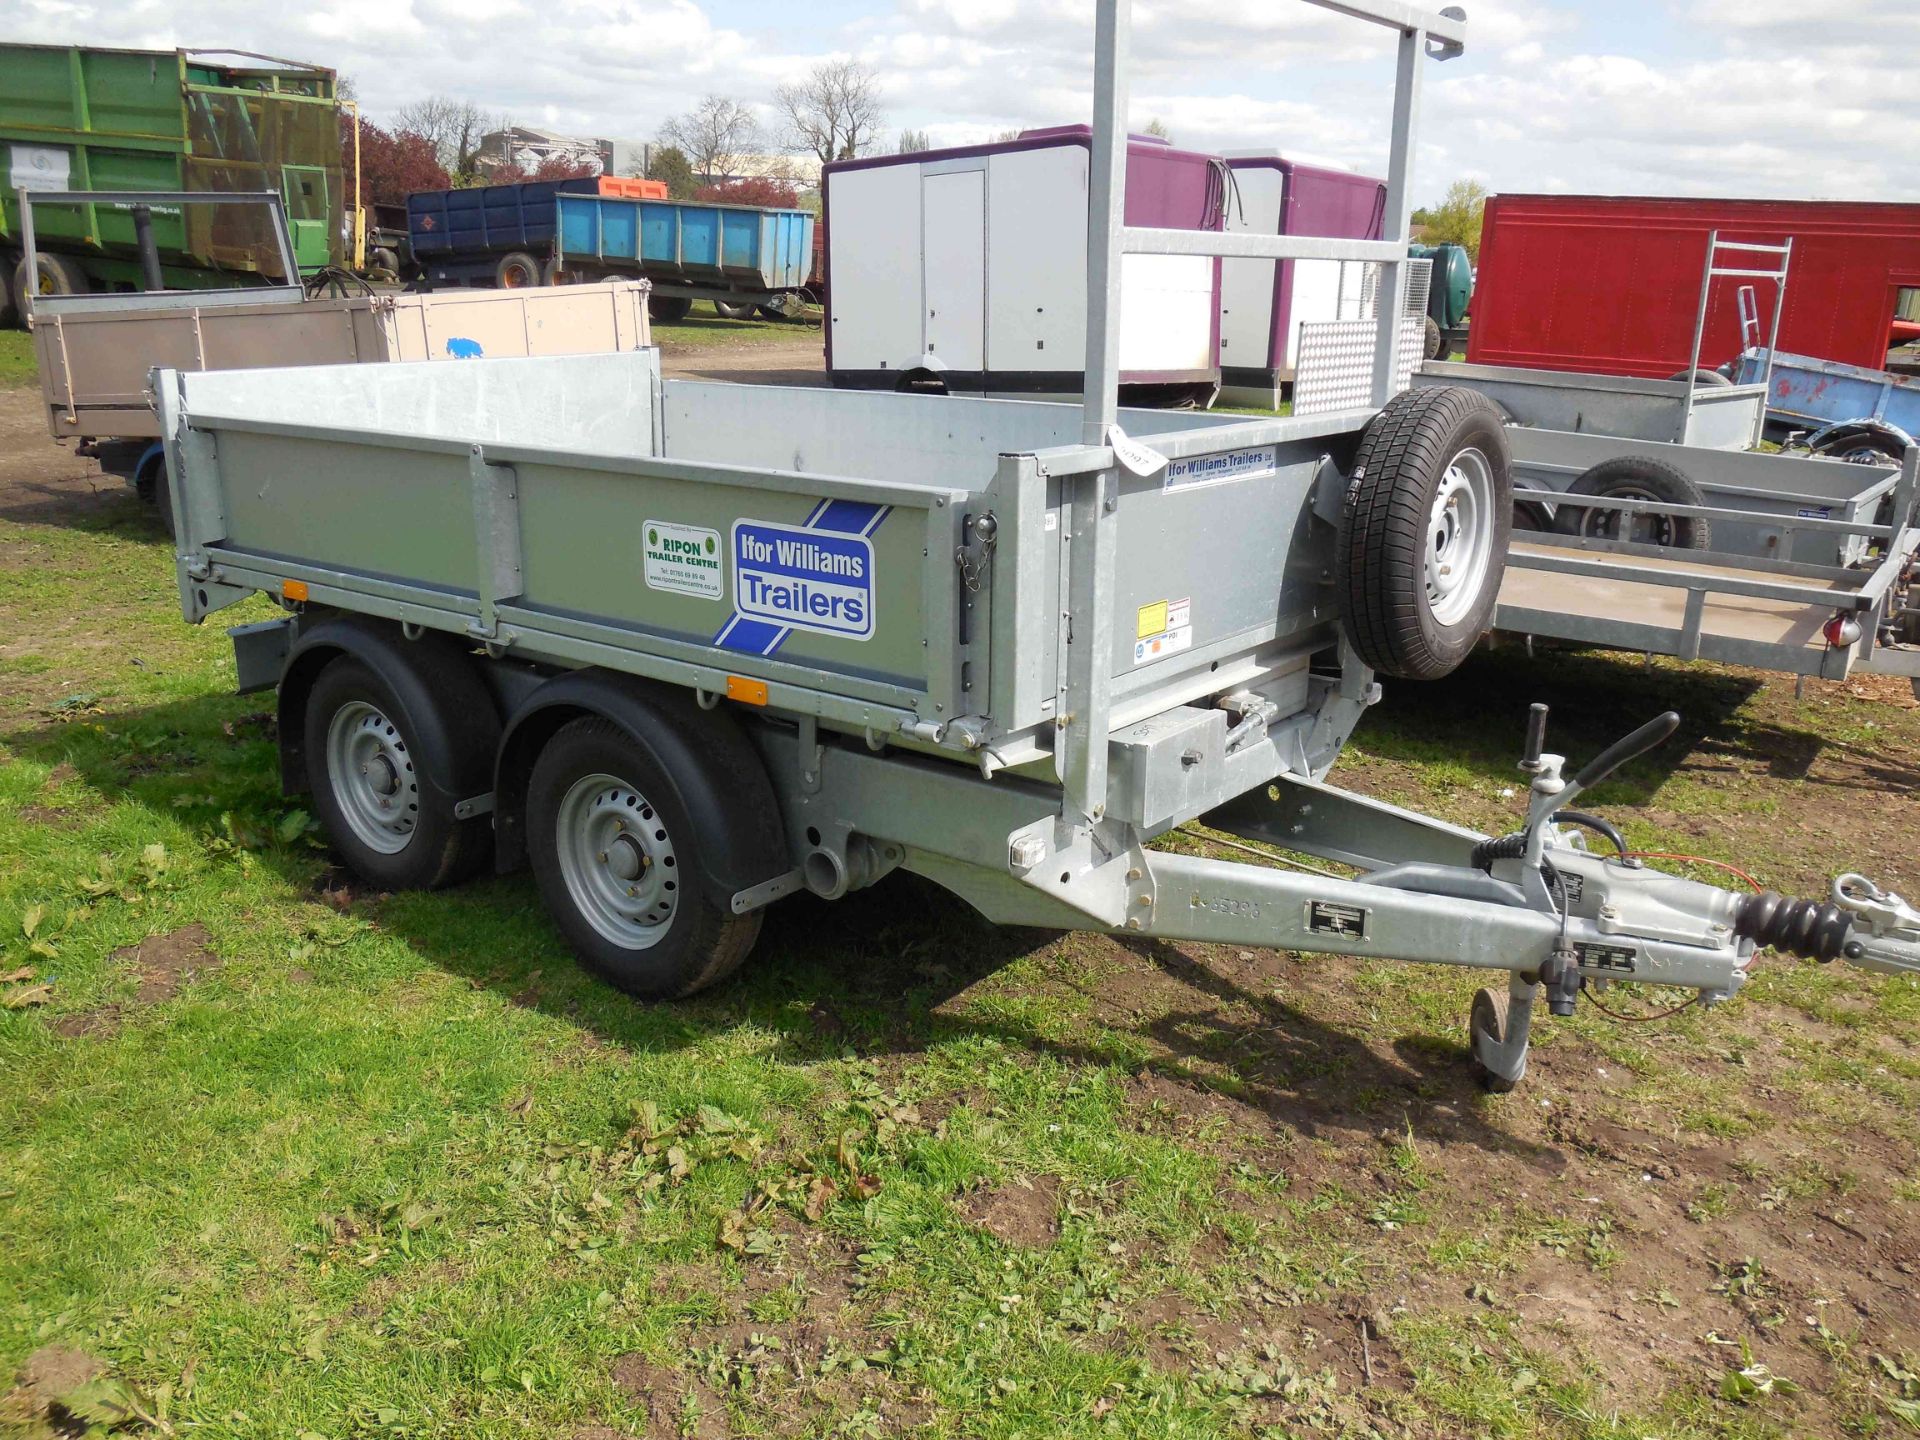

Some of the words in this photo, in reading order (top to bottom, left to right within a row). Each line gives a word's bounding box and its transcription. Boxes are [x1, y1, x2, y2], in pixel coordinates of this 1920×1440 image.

[1168, 464, 1186, 477] Ifor
[1187, 458, 1227, 474] Williams
[1228, 453, 1262, 467] Trailers
[663, 538, 701, 556] RIPON
[742, 534, 773, 563] Ifor
[776, 539, 863, 578] Williams
[647, 551, 683, 564] TRAILER
[685, 557, 719, 569] CENTRE
[743, 573, 863, 623] Trailers
